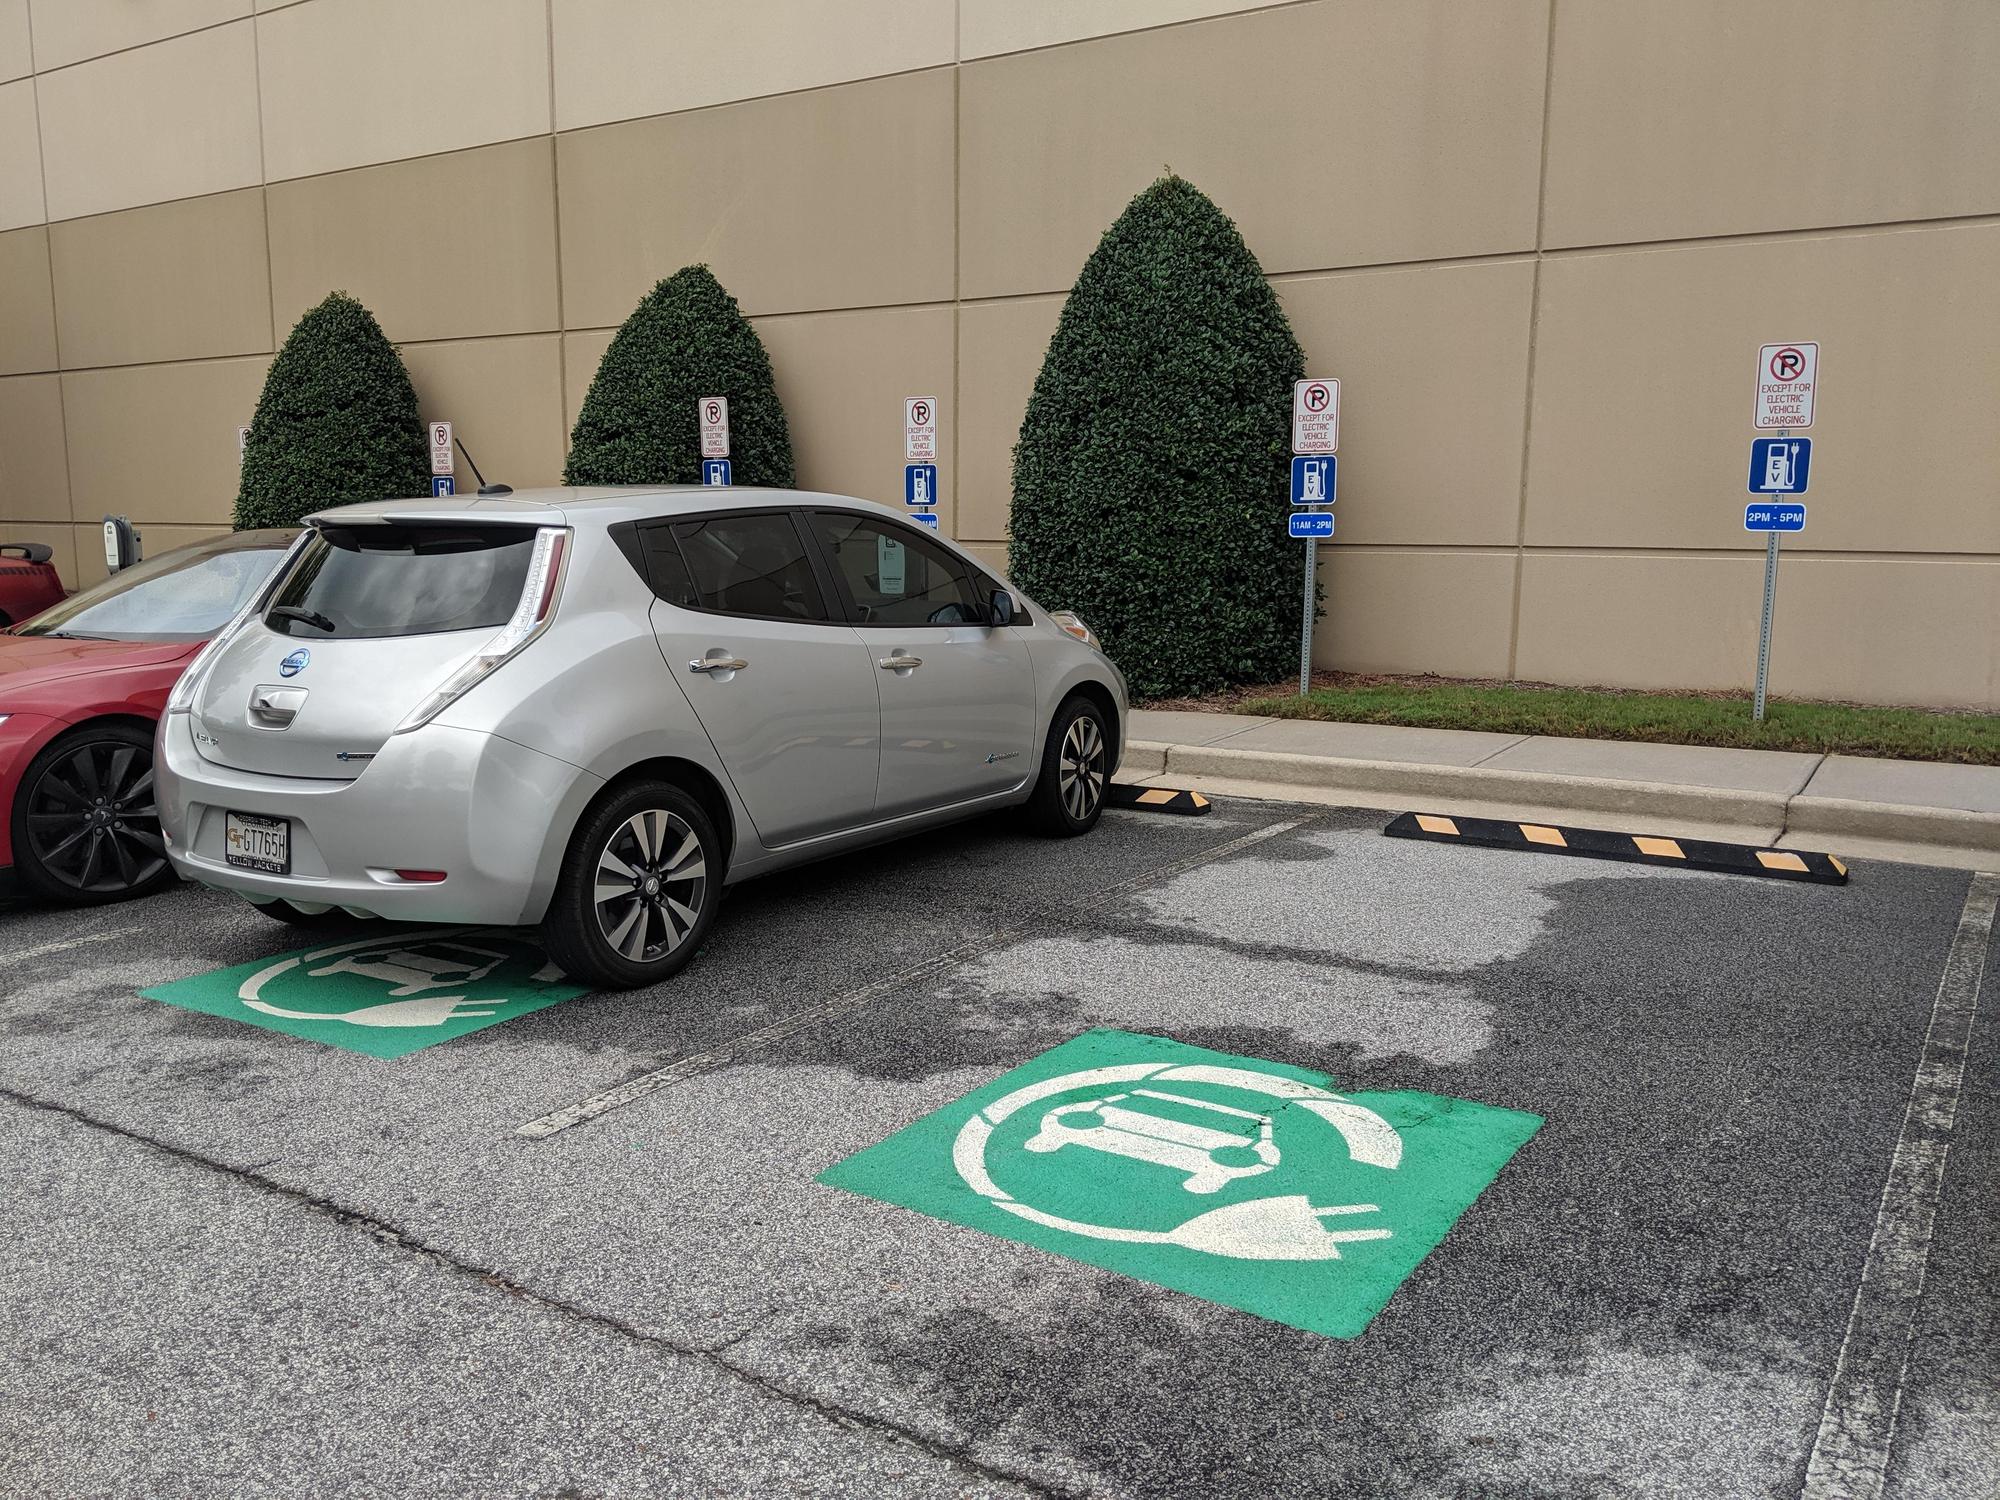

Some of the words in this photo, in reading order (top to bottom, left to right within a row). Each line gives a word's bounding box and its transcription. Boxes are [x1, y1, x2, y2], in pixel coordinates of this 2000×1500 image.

[1761, 384, 1792, 393] EXCEPT
[1794, 383, 1811, 392] FOR
[1766, 394, 1804, 403] ELECTRIC
[1769, 405, 1801, 414] VEHICLE
[1298, 414, 1321, 422] EXCEPT
[1322, 413, 1334, 421] FOR
[1762, 416, 1806, 425] CHARGING
[1302, 423, 1330, 431] ELECTRIC
[1304, 432, 1328, 440] VEHICLE
[1299, 441, 1331, 449] CHARGING
[1748, 513, 1771, 522] 2PM
[1779, 513, 1802, 522] 5PM
[1292, 521, 1311, 529] 11AM
[1316, 521, 1332, 529] 2PM
[244, 828, 285, 859] GT765H
